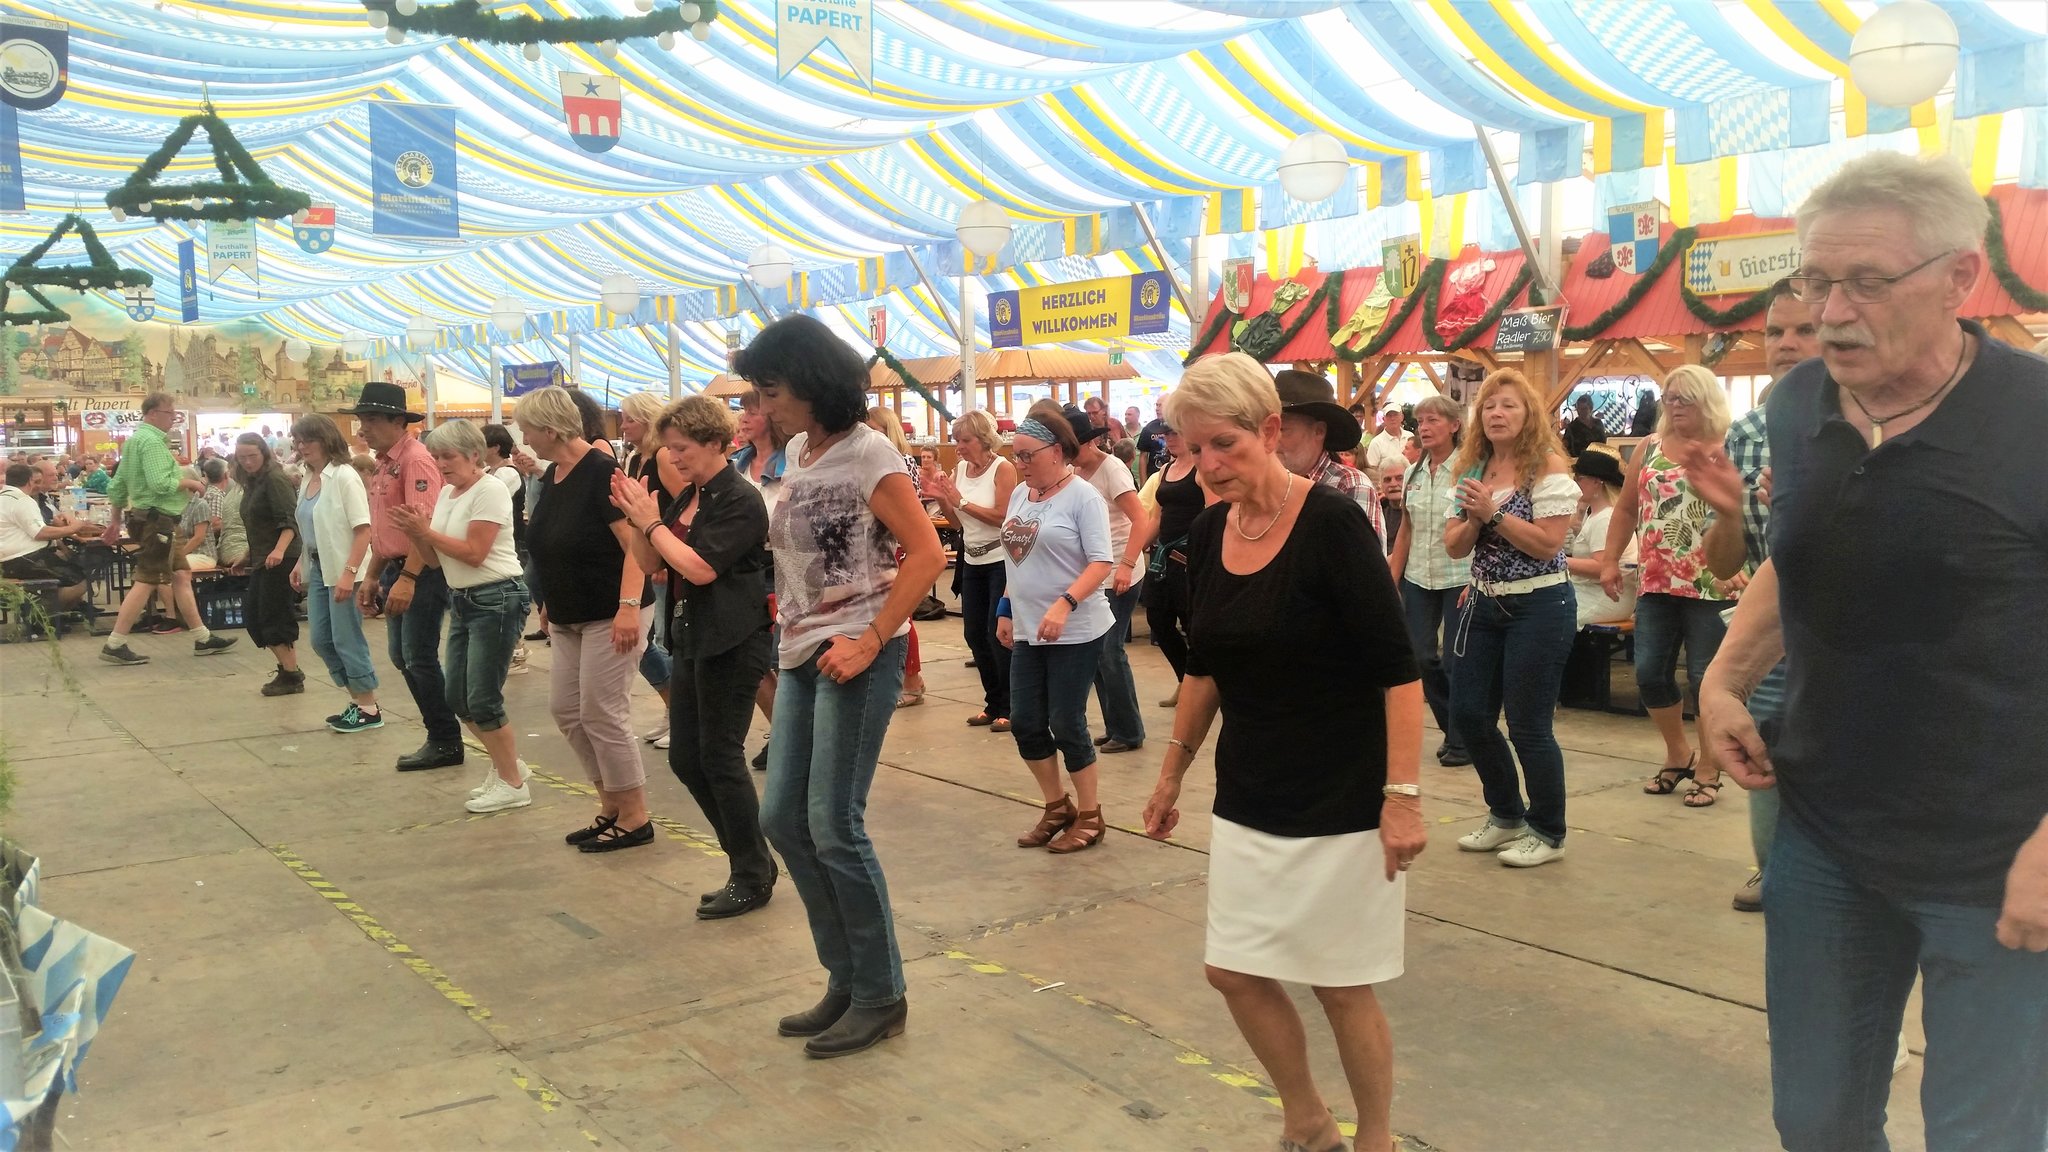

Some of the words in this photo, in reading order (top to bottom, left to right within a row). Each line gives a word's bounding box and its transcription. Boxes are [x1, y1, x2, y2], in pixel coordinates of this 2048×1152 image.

[787, 5, 863, 32] PAPERT
[1041, 288, 1106, 311] HERZLICH
[1032, 312, 1118, 335] WILLKOMMEN
[1500, 315, 1528, 328] Maß
[1530, 313, 1554, 325] Bier
[1496, 331, 1531, 345] Radler
[84, 397, 130, 411] Papert
[1003, 530, 1033, 546] Spatzl
